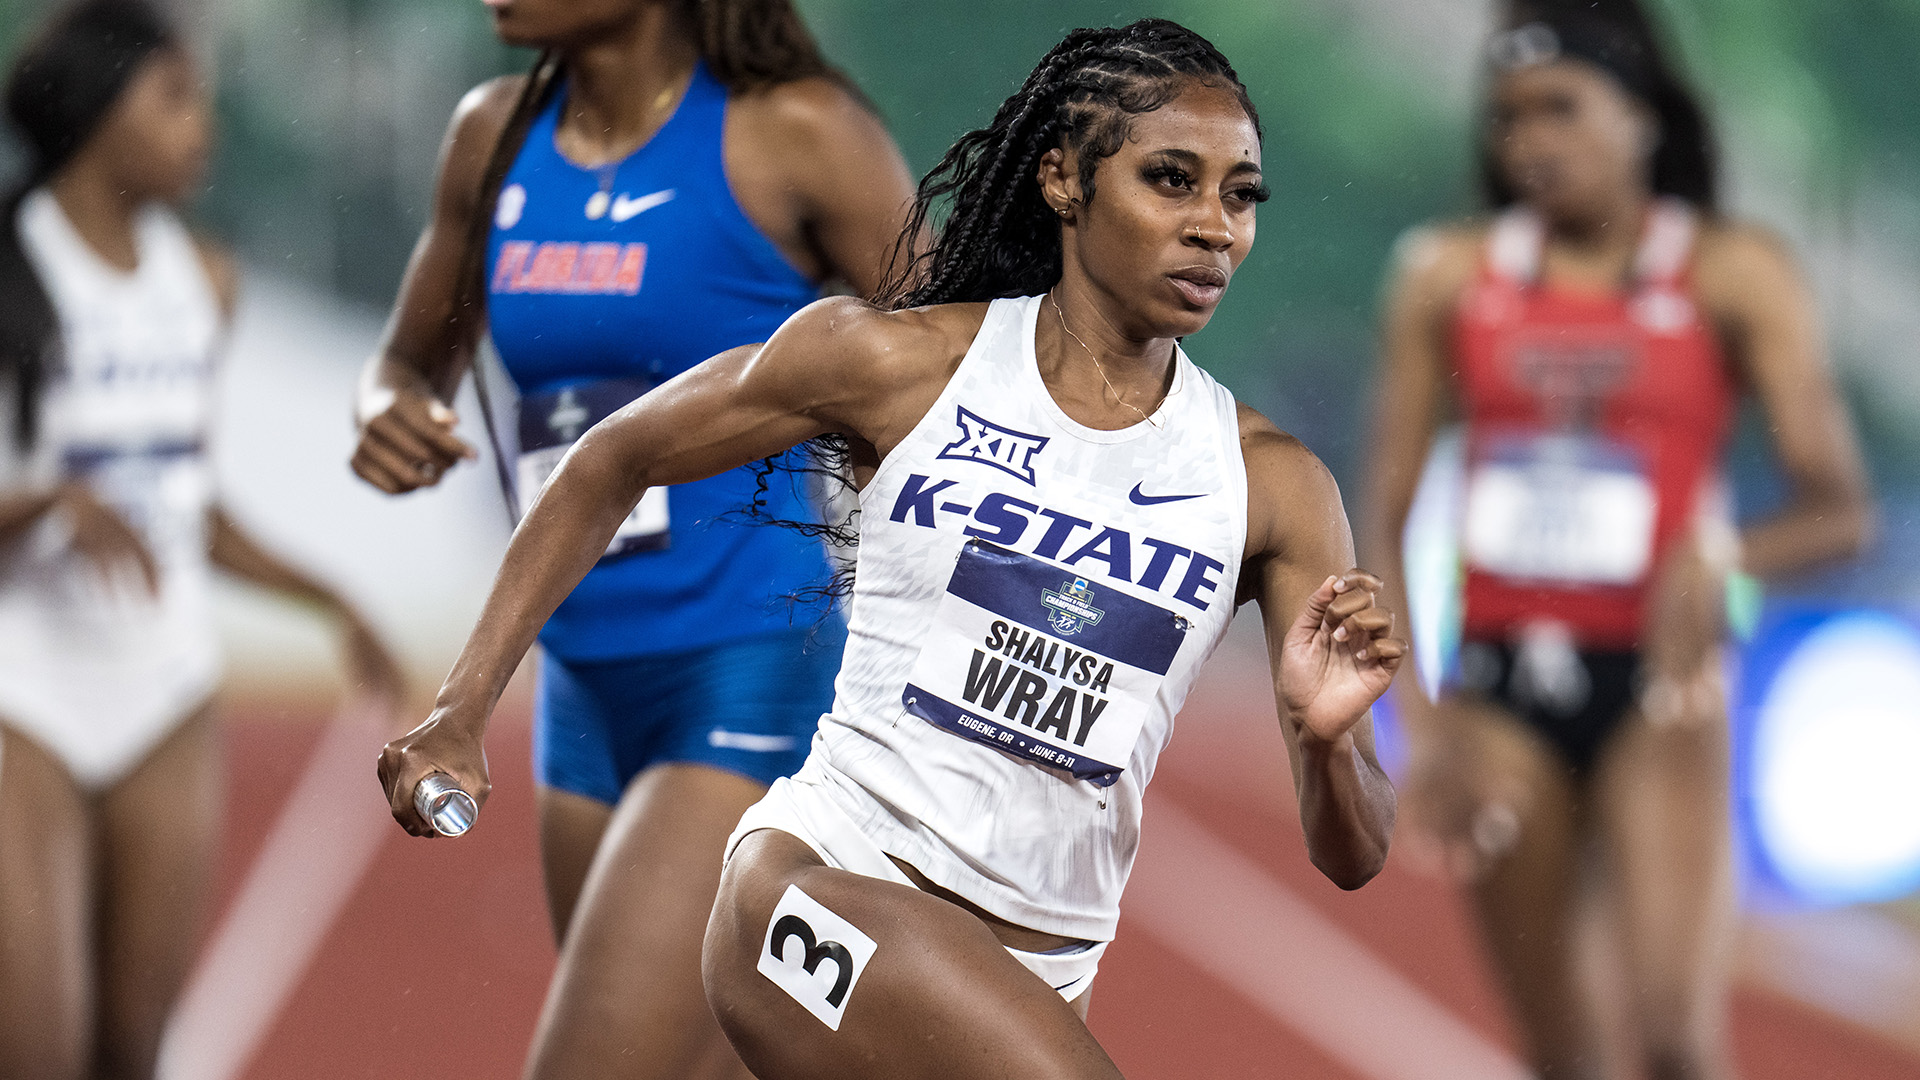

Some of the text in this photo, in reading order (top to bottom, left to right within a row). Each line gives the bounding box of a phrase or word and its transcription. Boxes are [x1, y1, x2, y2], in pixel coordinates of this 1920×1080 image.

[491, 240, 648, 297] FLORIDA
[889, 473, 1225, 612] K-STATE
[1045, 595, 1098, 620] CHAMPIONSHIPS
[985, 620, 1114, 694] SHALYSA
[962, 648, 1109, 747] WRAY
[957, 714, 997, 739] EUGENE,
[998, 731, 1015, 744] OR
[1029, 744, 1057, 761] JUNE
[1055, 754, 1076, 768] 8-11
[770, 914, 854, 1009] 3
